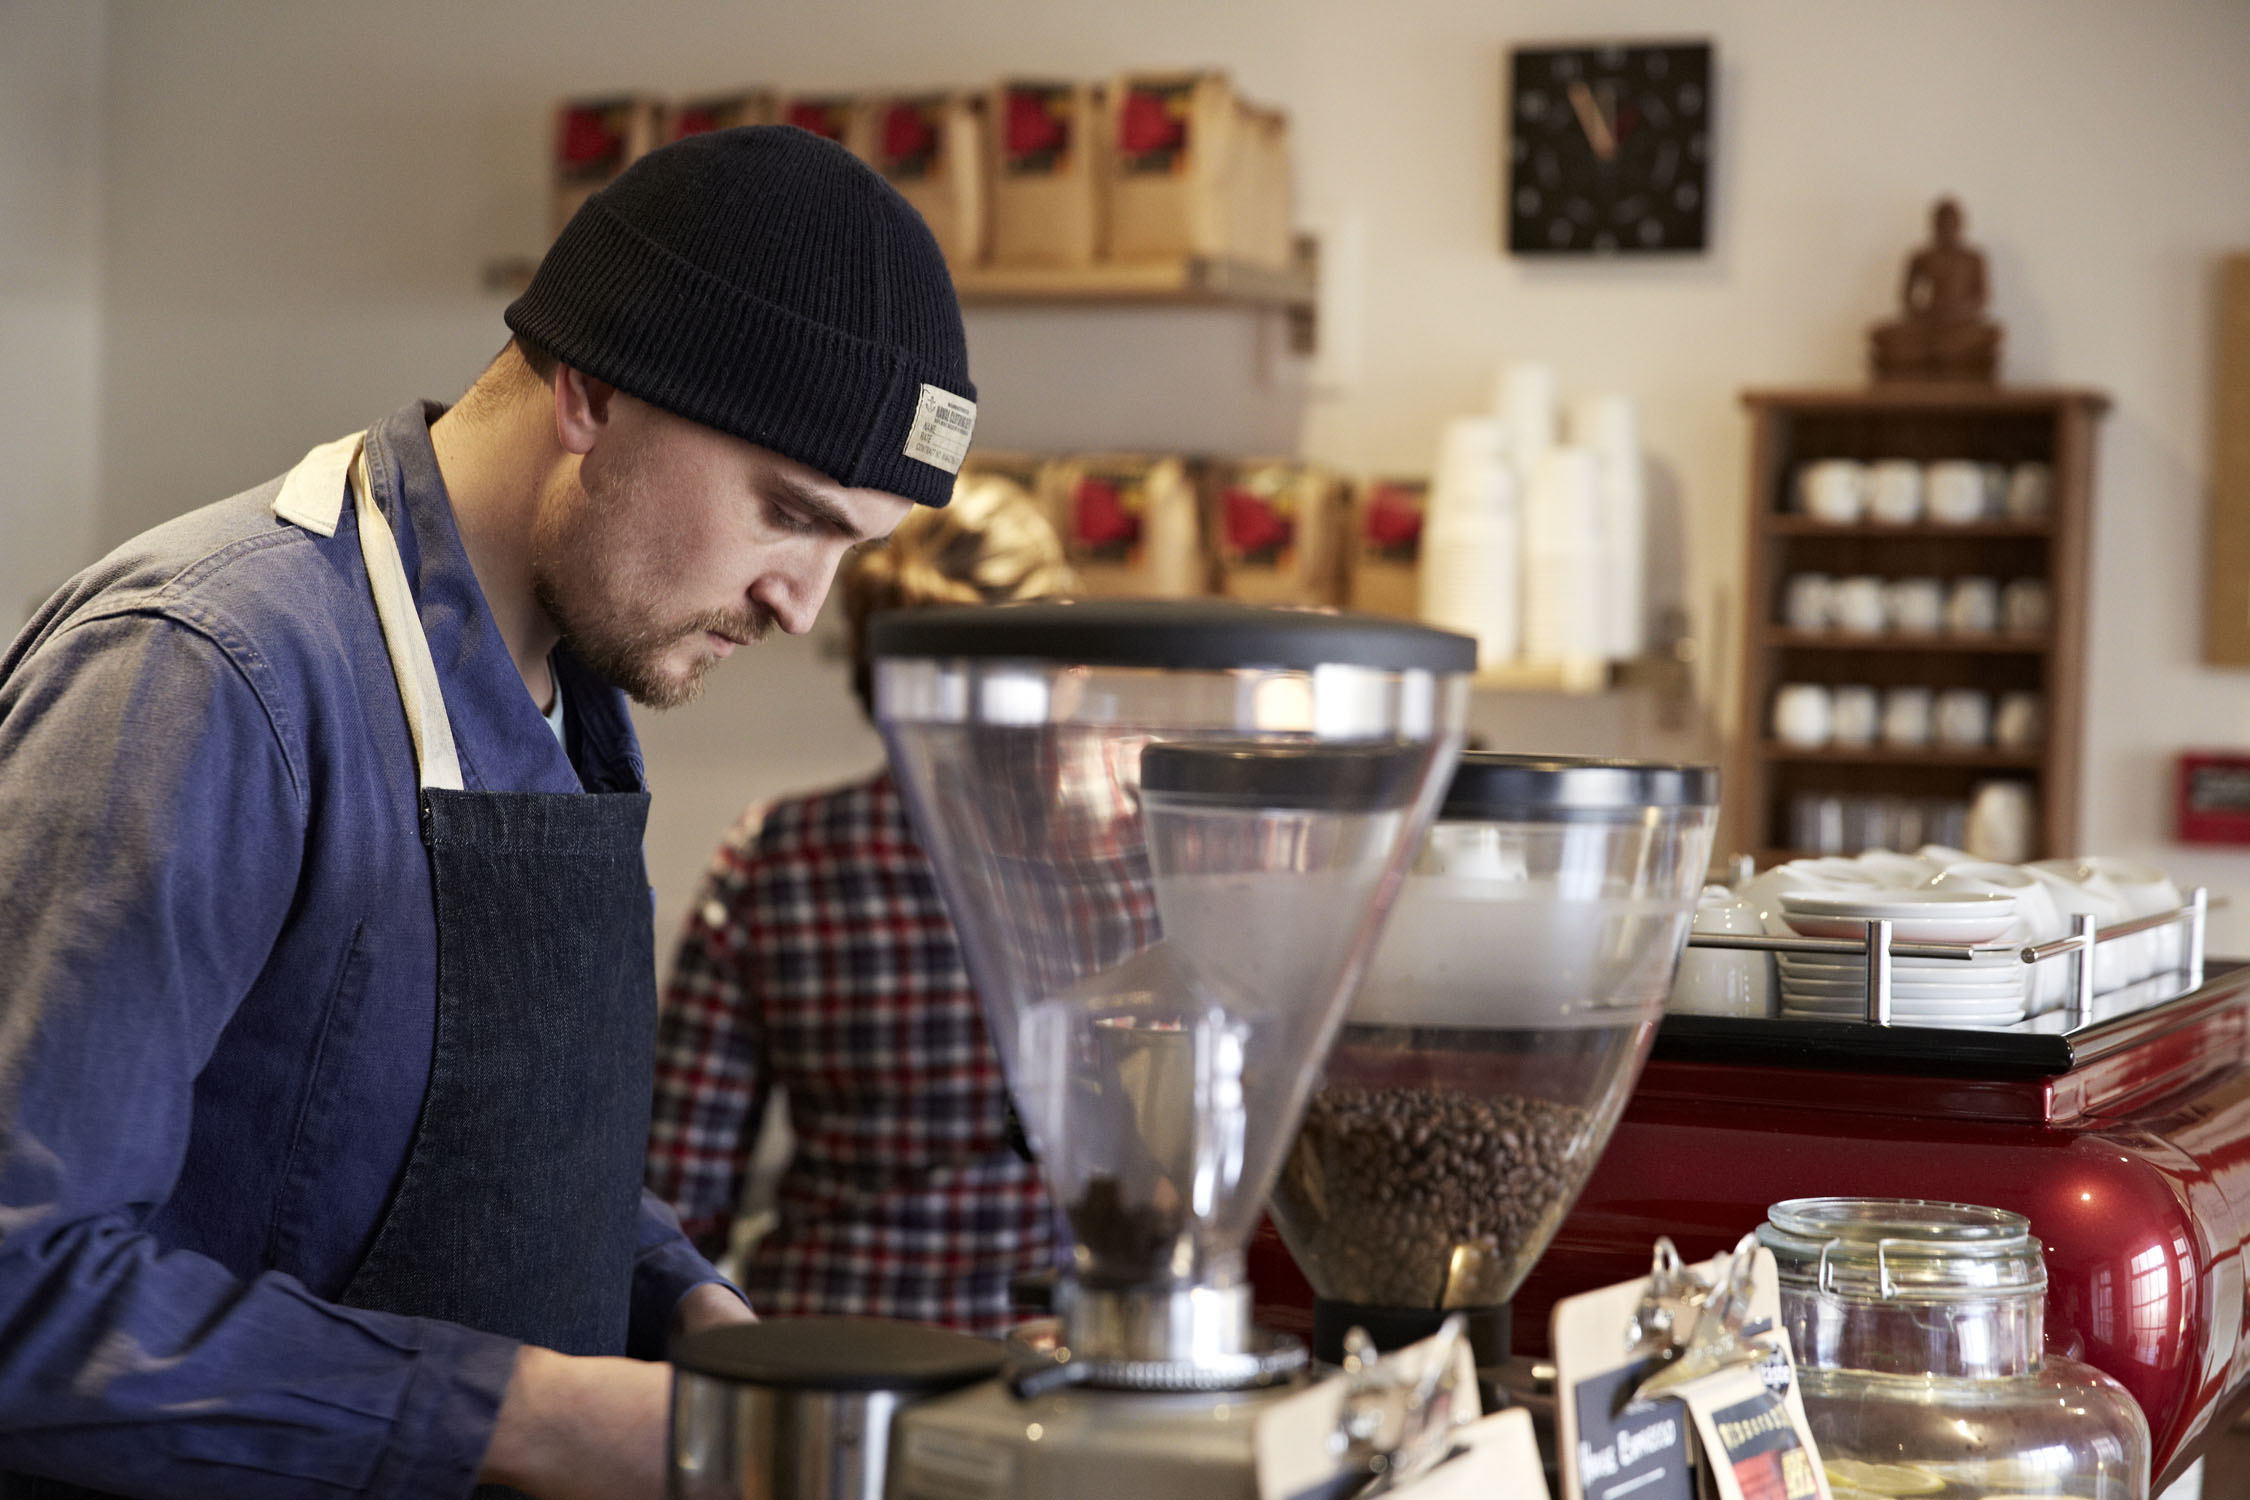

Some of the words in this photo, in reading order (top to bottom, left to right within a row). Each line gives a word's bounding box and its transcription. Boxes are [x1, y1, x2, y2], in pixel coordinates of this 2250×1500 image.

[923, 421, 937, 434] NAME
[919, 431, 932, 443] RATE
[915, 443, 936, 456] CONTRACT
